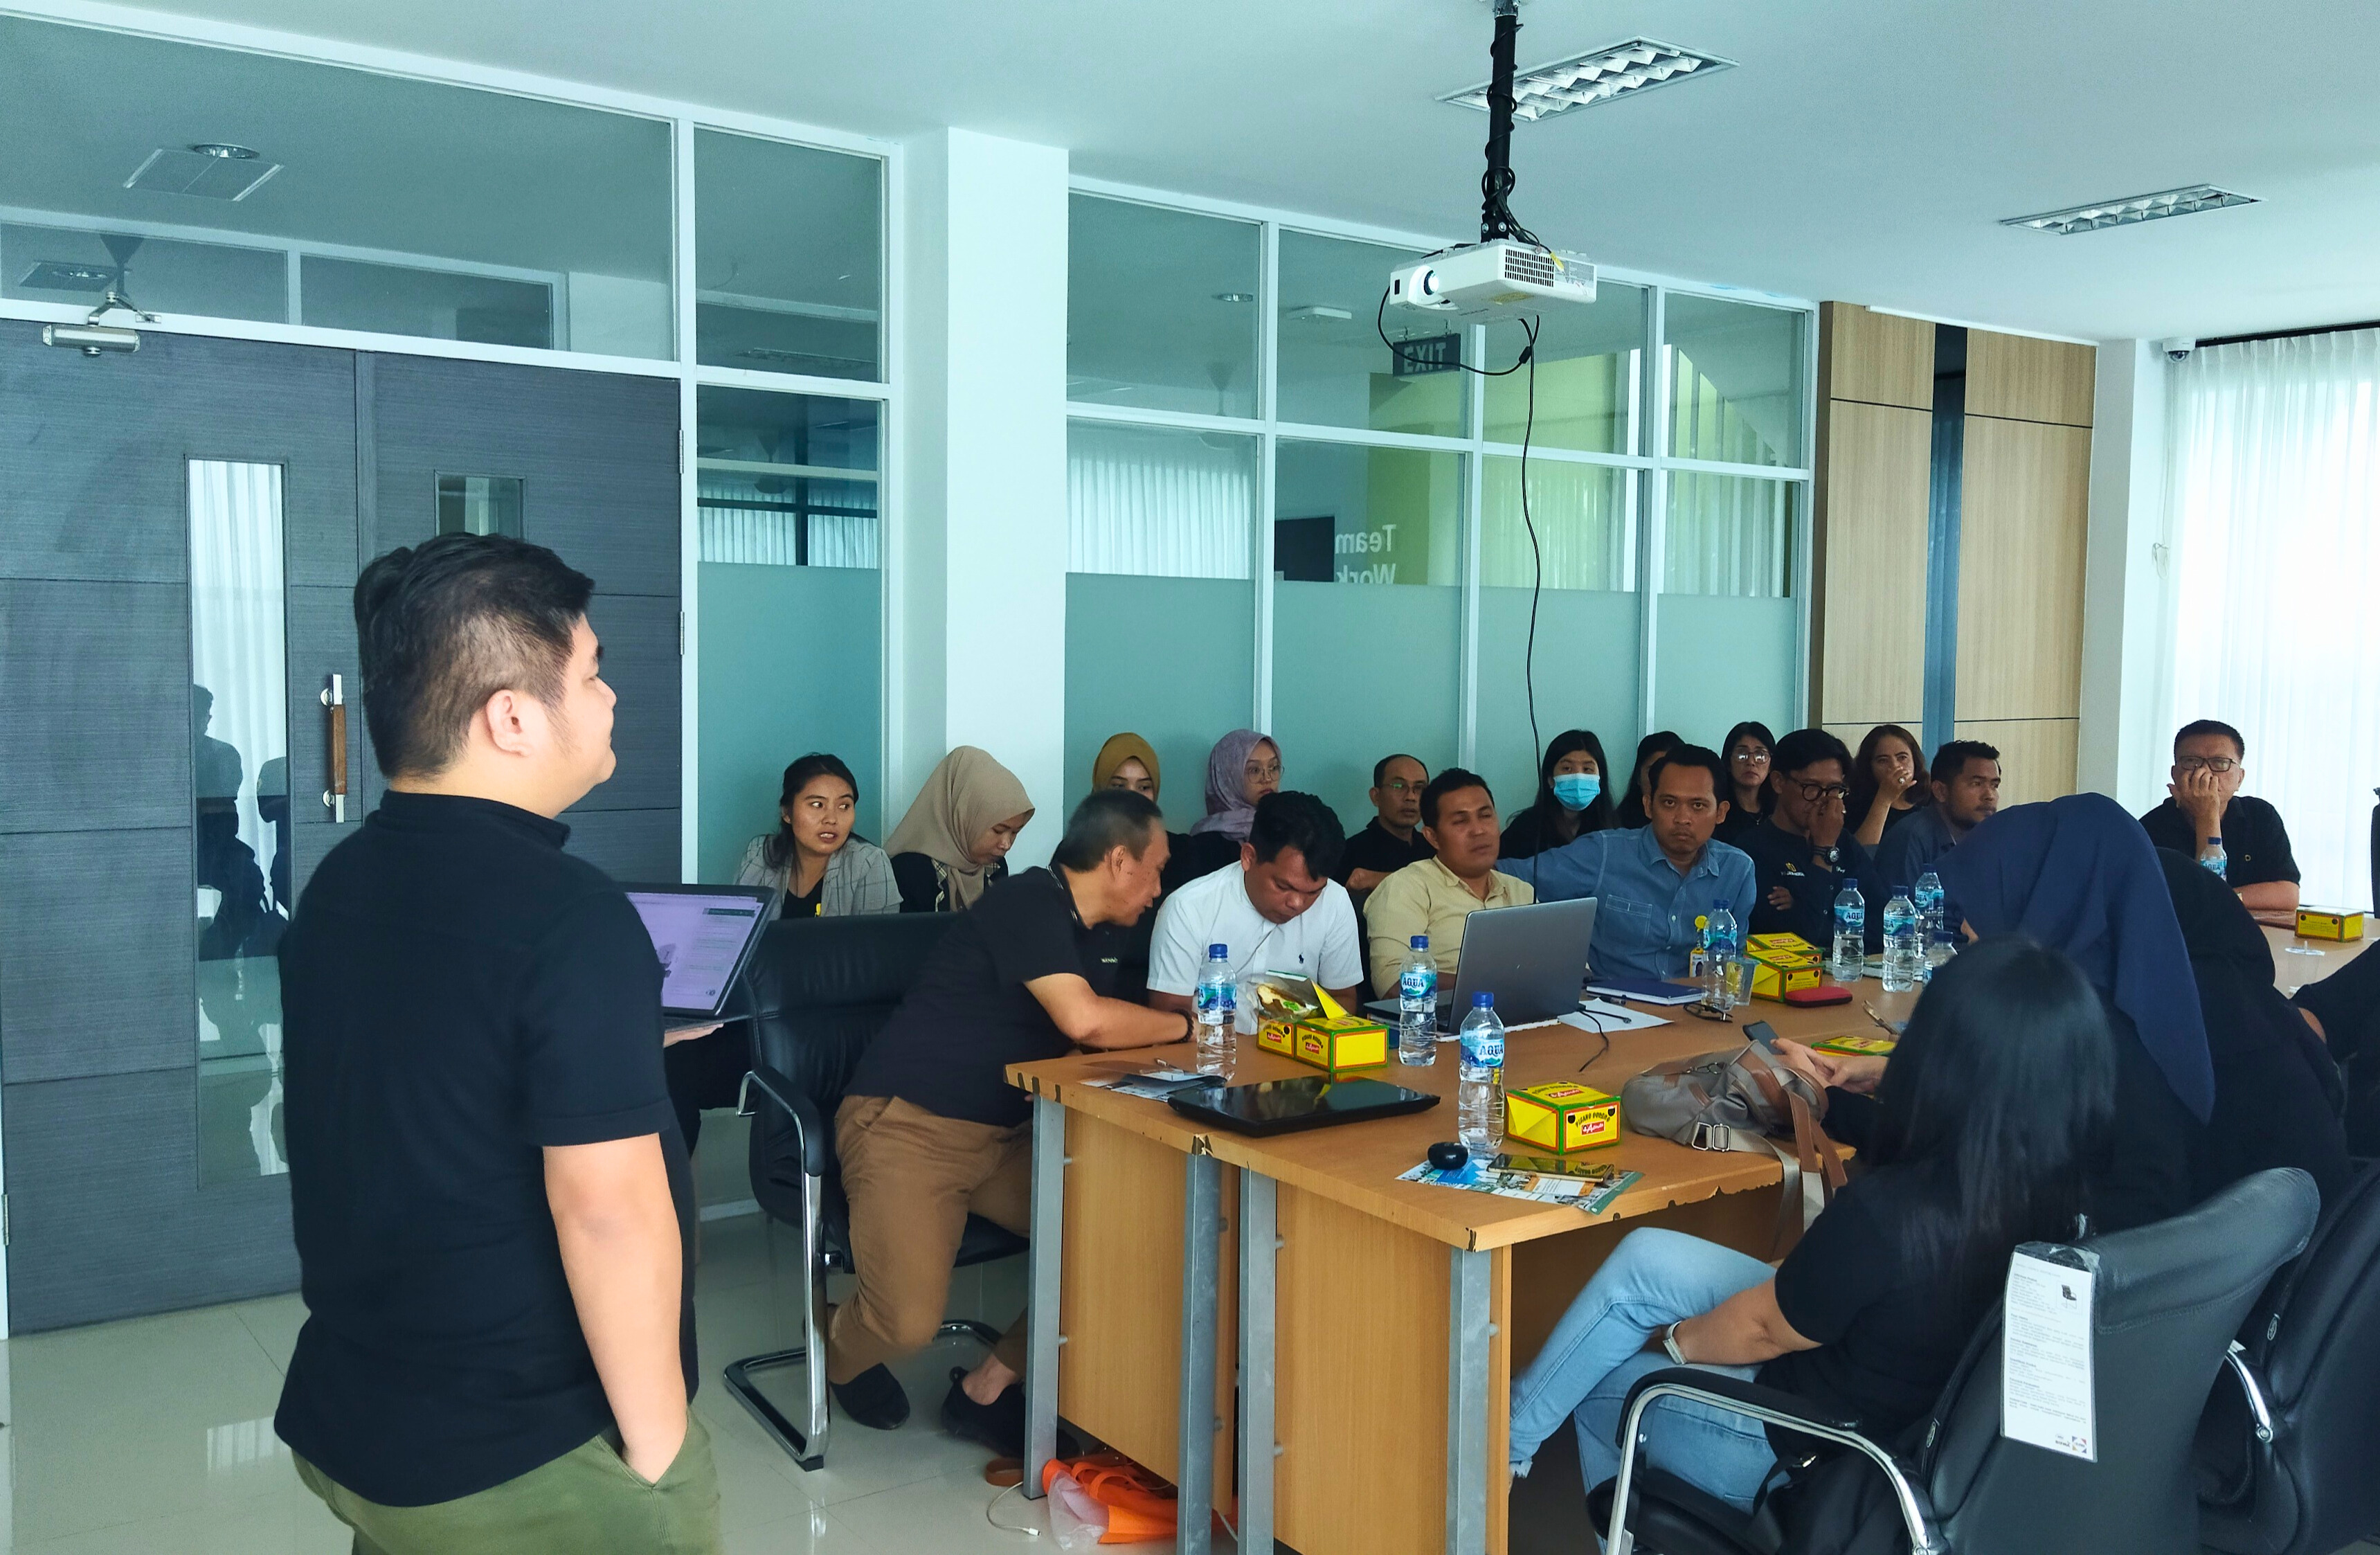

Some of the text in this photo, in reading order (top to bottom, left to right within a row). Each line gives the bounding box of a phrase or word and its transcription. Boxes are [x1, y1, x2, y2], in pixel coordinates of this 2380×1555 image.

[1404, 342, 1446, 373] EXIT
[1403, 977, 1425, 989] AQUA
[1479, 1044, 1504, 1057] AQUA
